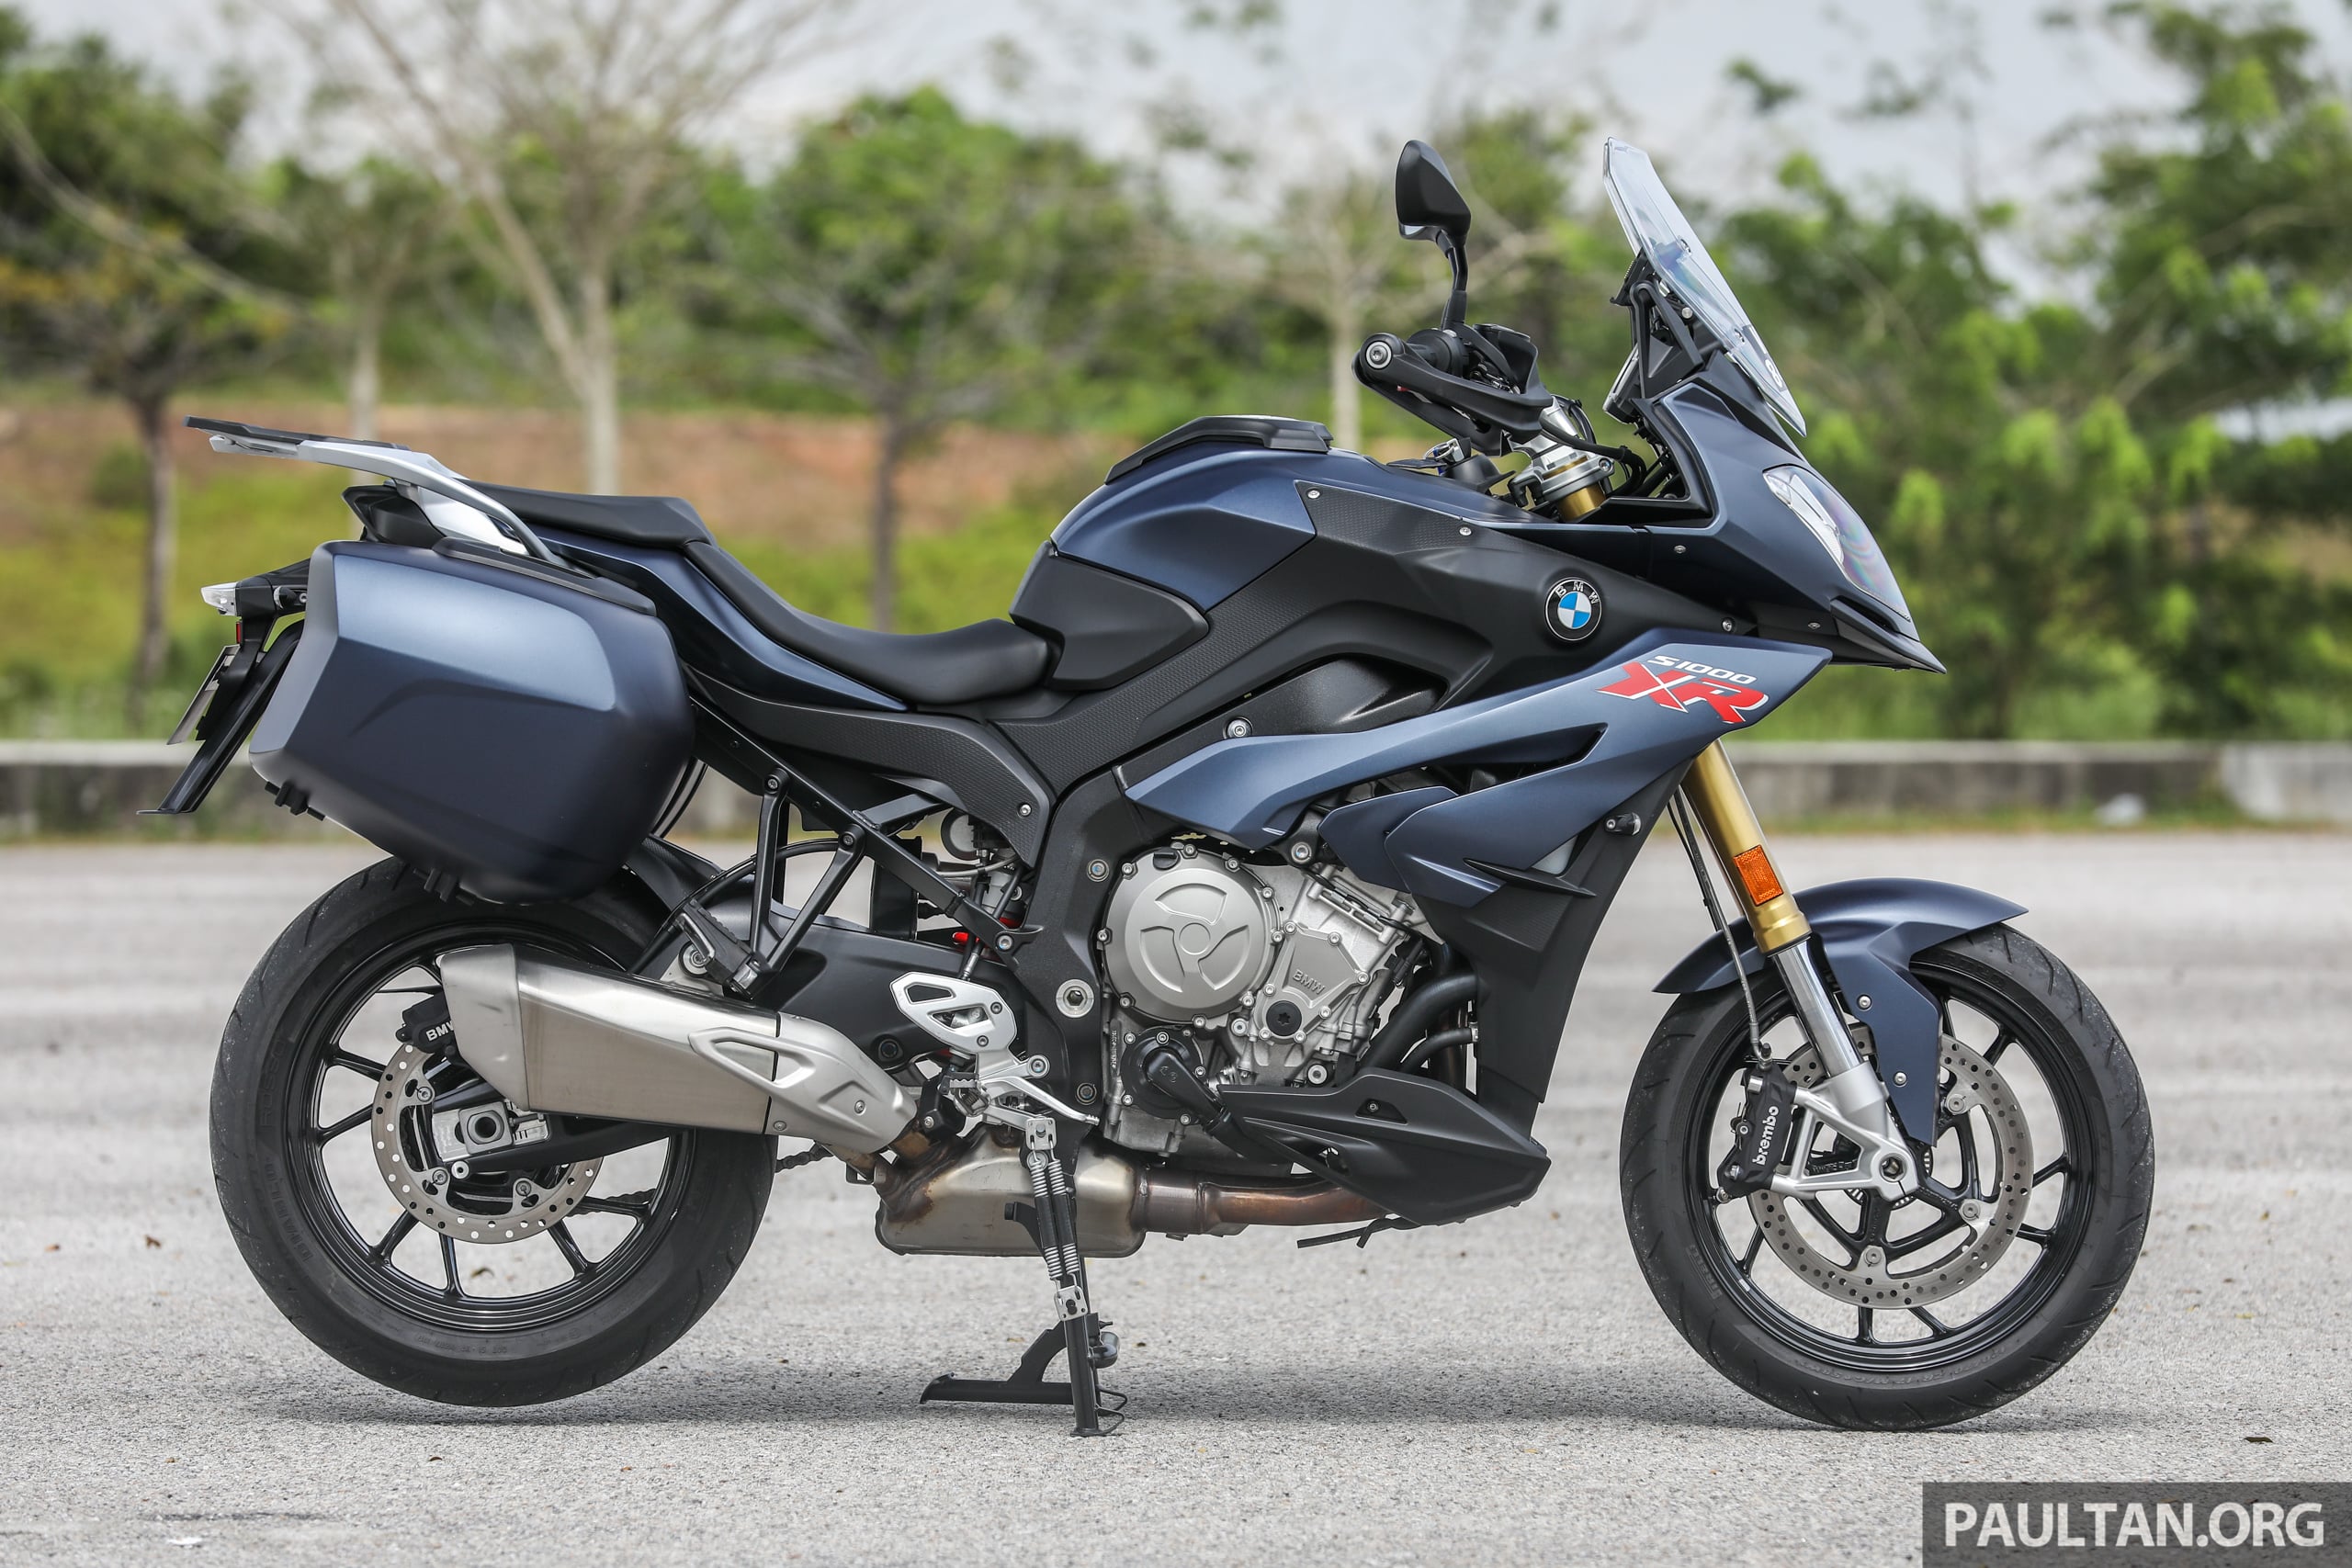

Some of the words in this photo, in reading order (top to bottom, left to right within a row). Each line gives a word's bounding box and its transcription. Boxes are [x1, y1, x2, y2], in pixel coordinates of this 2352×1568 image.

[1555, 580, 1600, 604] BMW
[1646, 654, 1757, 685] S1000
[1595, 660, 1770, 724] XR
[1292, 968, 1327, 994] BMW
[1751, 1105, 1780, 1166] brembo
